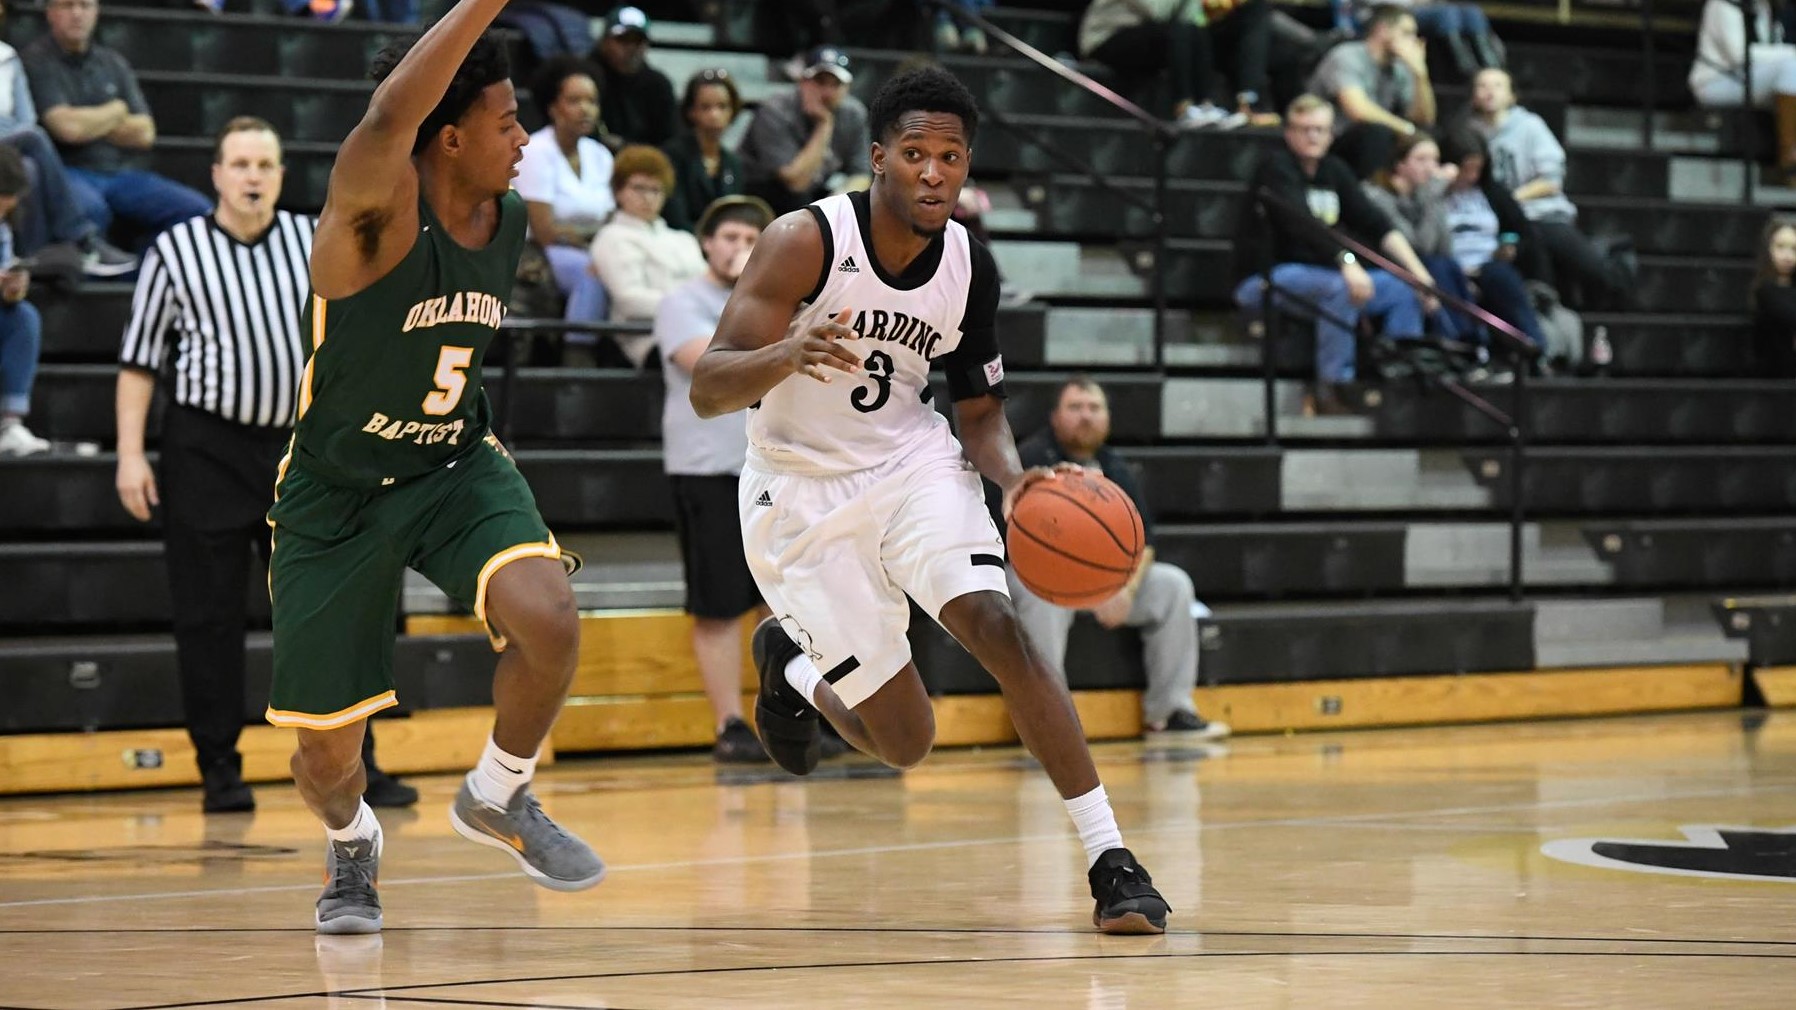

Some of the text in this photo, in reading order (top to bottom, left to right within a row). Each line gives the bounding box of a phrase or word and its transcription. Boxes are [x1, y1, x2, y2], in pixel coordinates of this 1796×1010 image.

[402, 291, 508, 333] OKLAHOM
[829, 309, 942, 362] ARDING
[421, 345, 475, 416] 5
[851, 350, 895, 413] 3
[362, 412, 465, 445] BAPTIST
